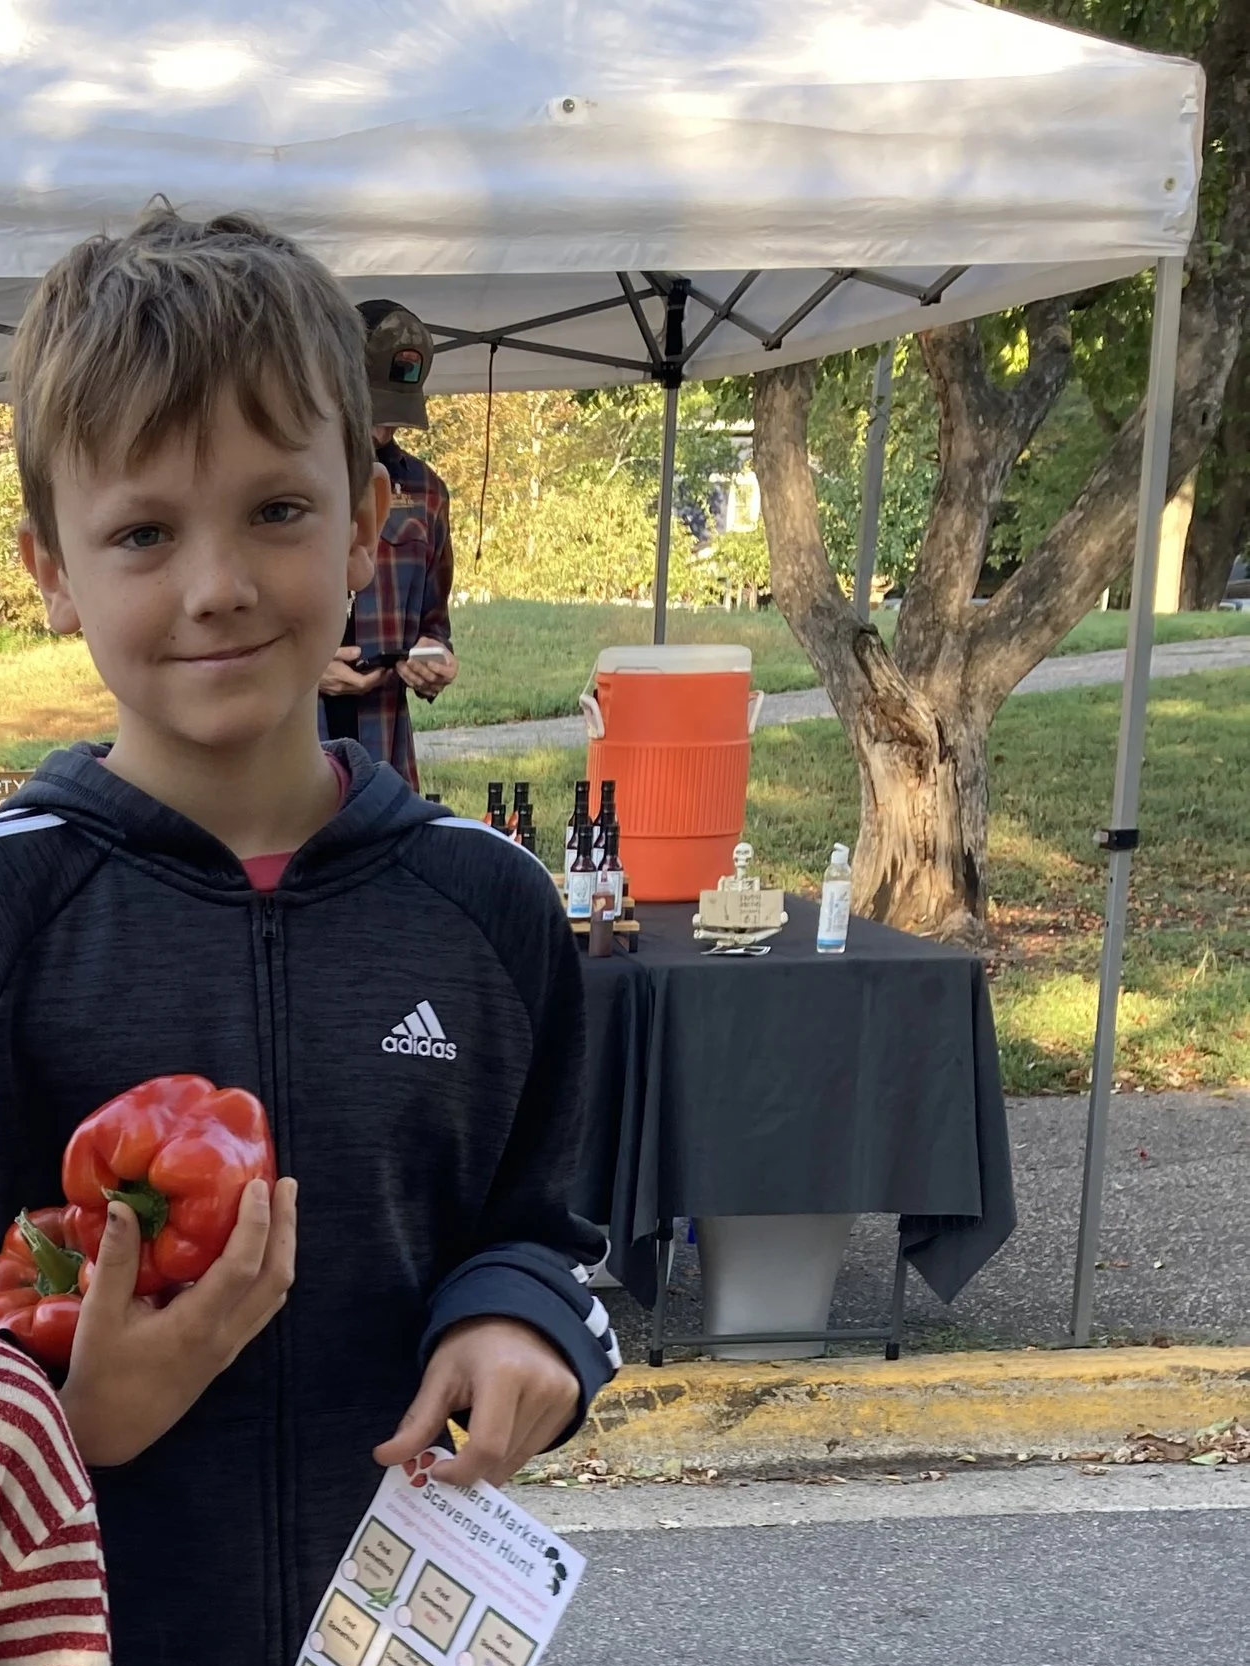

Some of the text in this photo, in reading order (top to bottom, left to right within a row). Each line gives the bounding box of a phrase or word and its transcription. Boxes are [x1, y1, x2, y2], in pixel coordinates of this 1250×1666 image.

[381, 1034, 458, 1061] adidas
[421, 1482, 495, 1544] Scavenger
[496, 1539, 534, 1577] Hunt
[493, 1504, 546, 1553] Market
